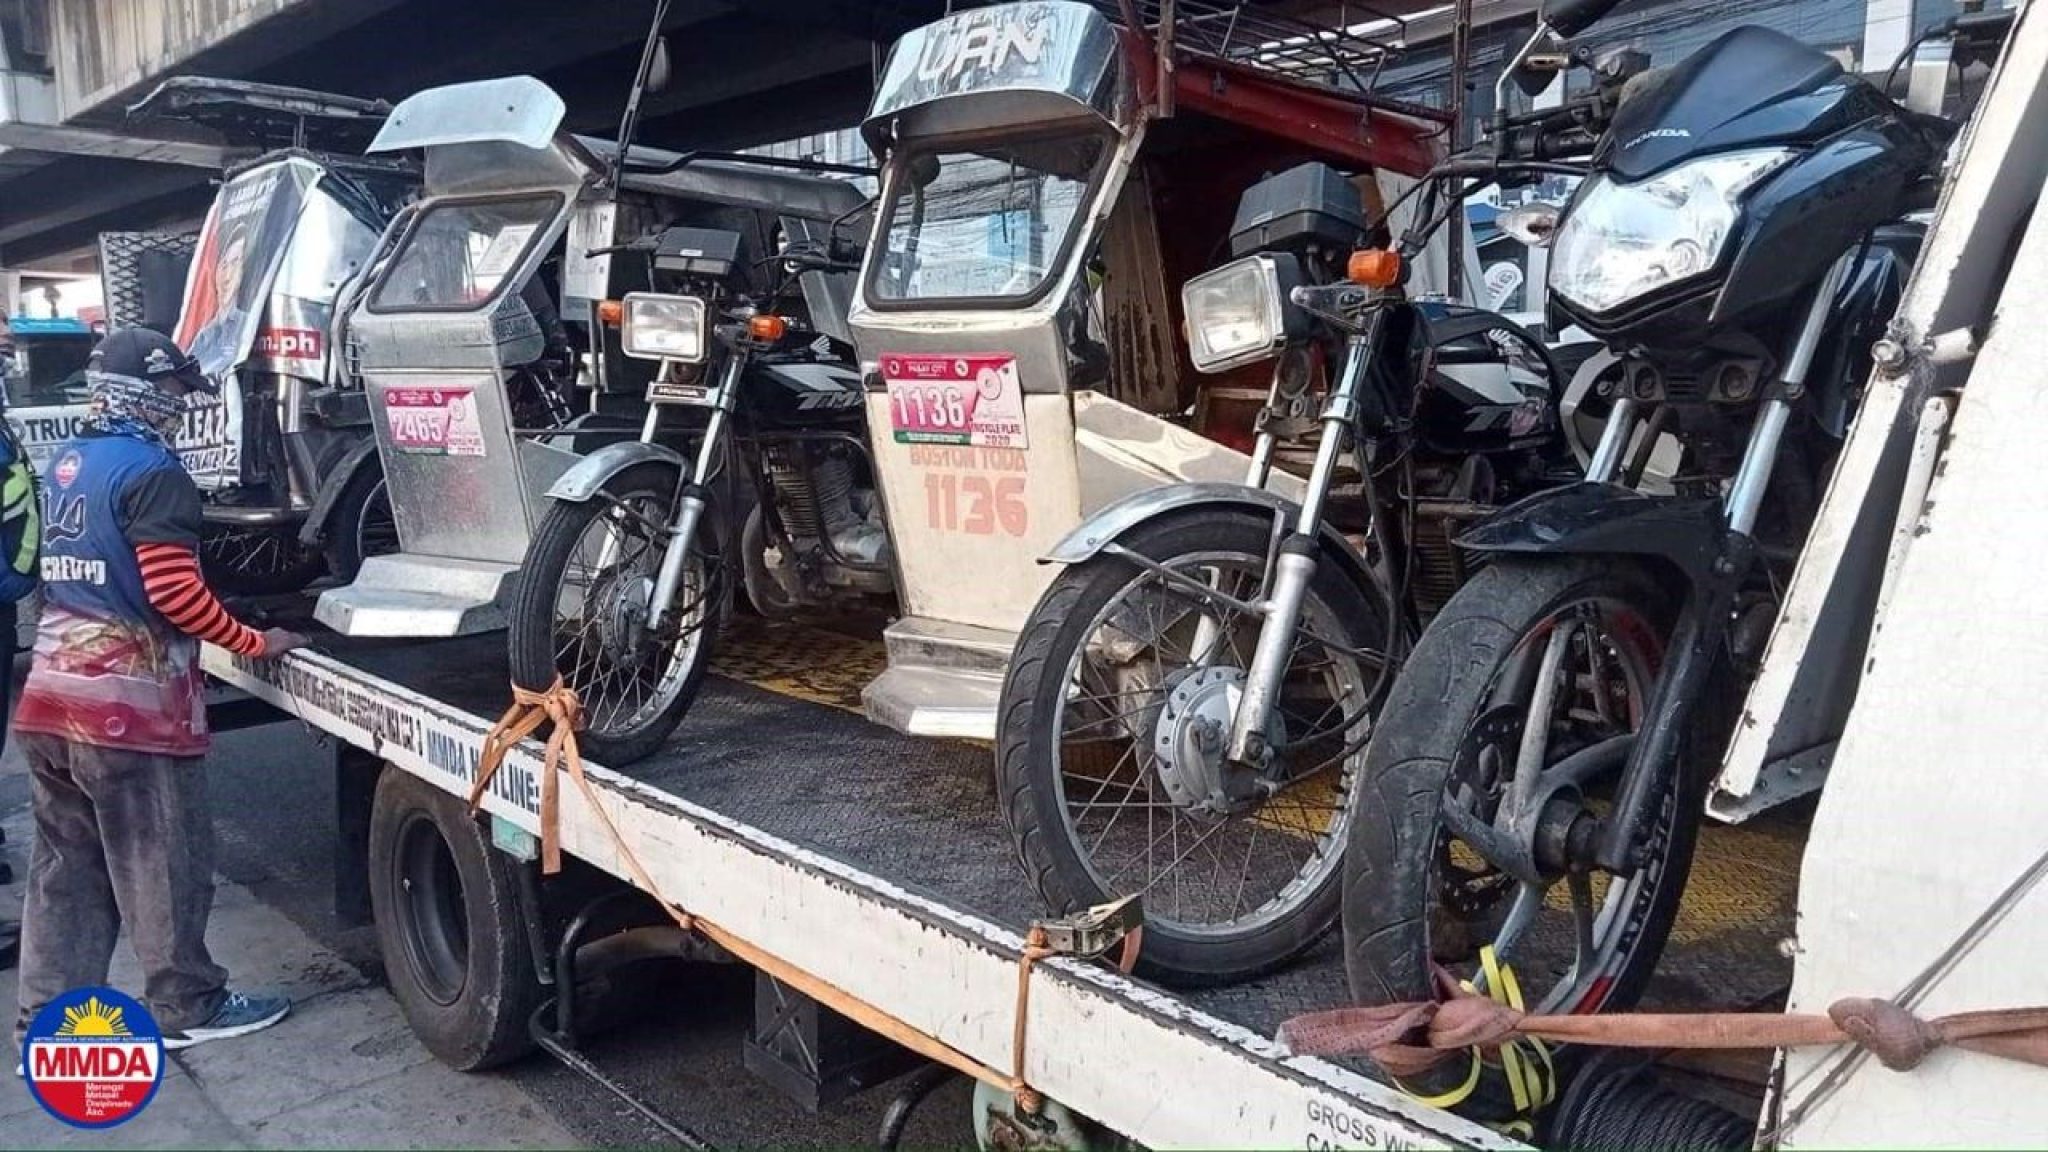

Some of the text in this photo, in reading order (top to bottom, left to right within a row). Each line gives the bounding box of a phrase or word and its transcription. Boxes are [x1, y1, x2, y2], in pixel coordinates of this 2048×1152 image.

[1625, 129, 1690, 149] HONDA
[391, 412, 443, 442] 2465
[893, 387, 965, 428] 1136
[910, 446, 1027, 472] BOSTON TODA
[924, 473, 1027, 537] 1136
[427, 728, 467, 781] MMDA
[1306, 1100, 1377, 1147] GROSS
